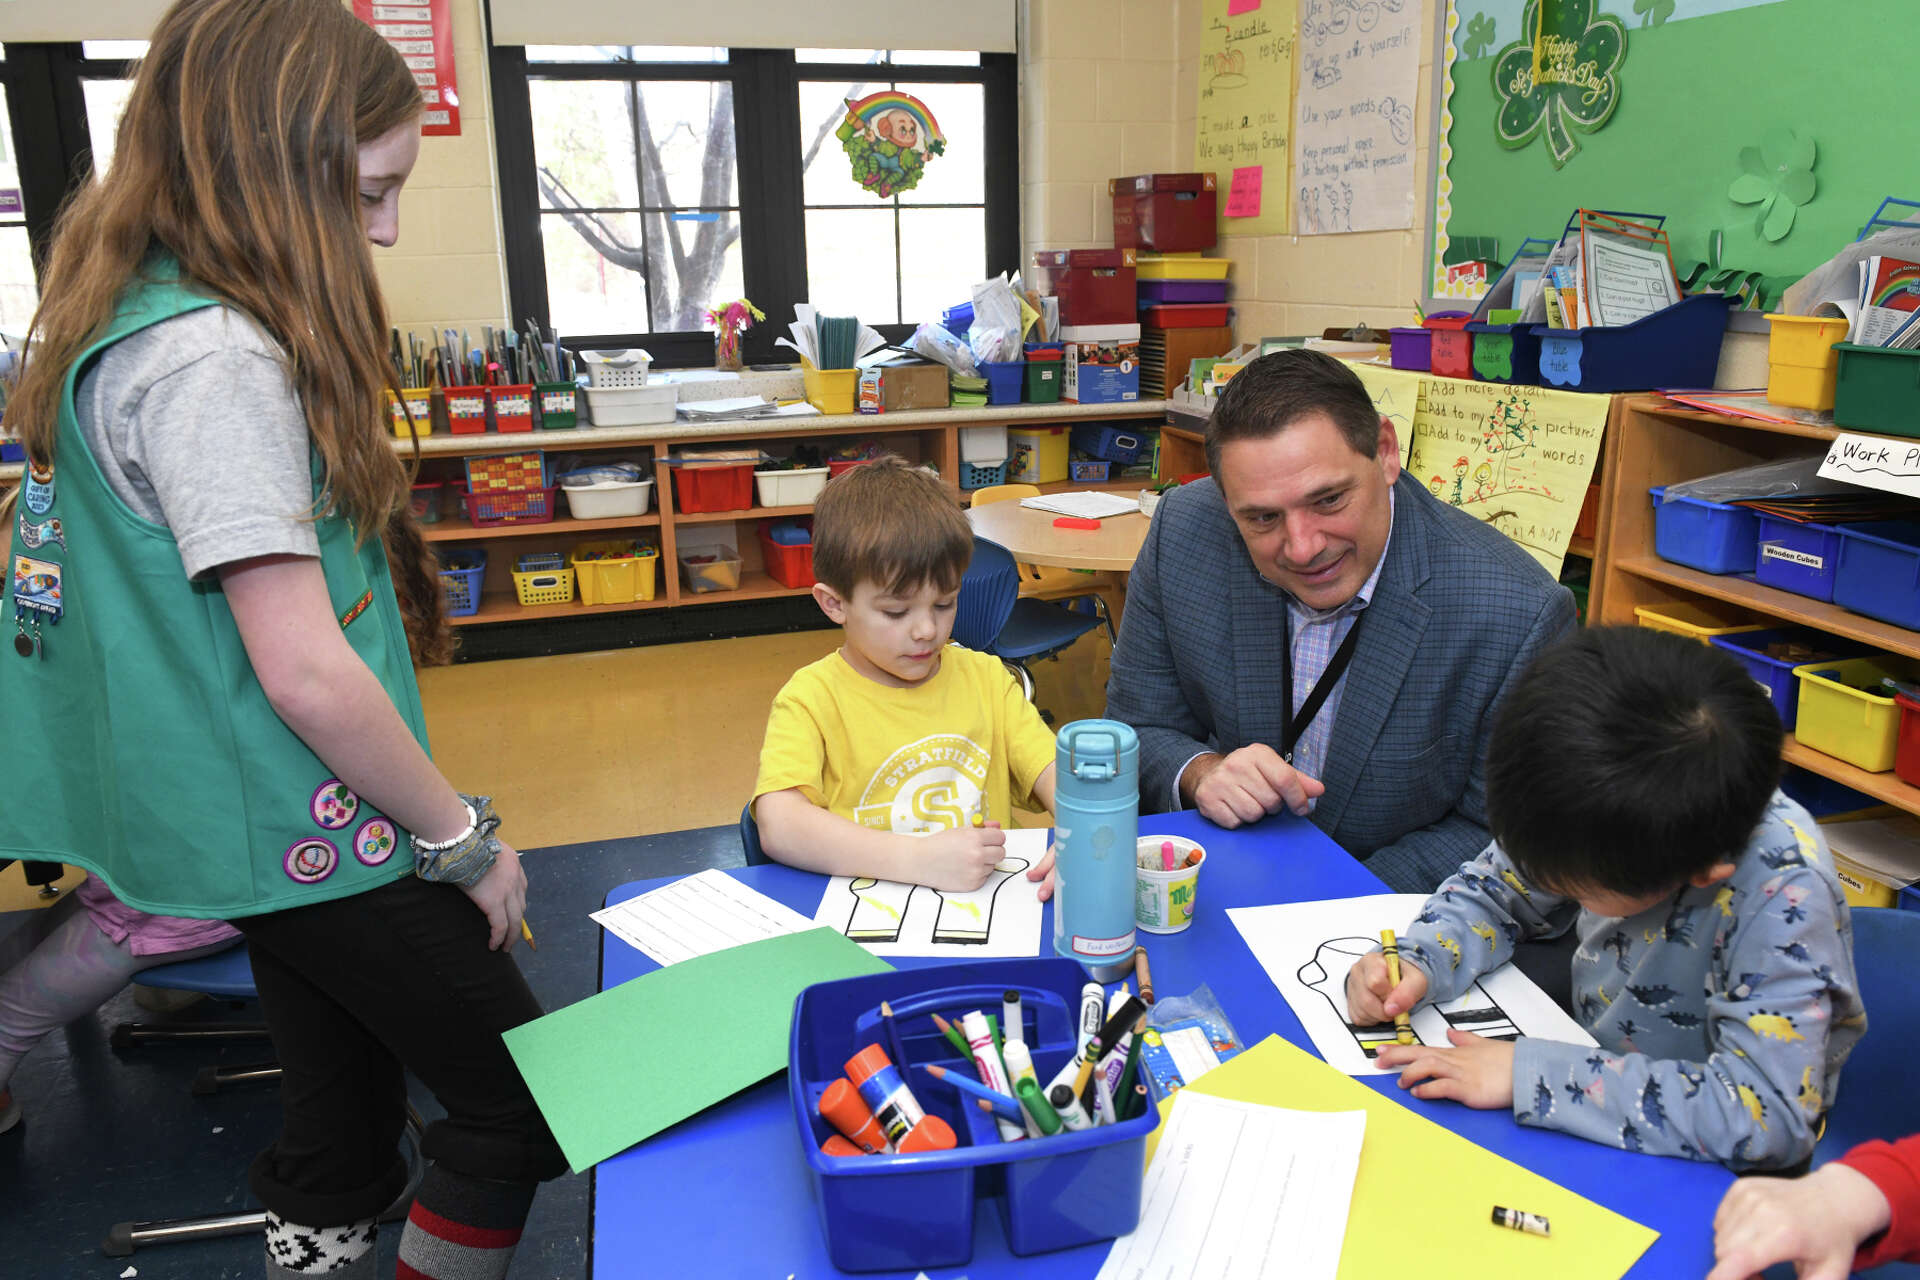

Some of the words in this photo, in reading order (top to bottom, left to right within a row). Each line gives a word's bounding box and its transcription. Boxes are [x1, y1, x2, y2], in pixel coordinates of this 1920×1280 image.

[1575, 60, 1608, 105] Day
[1430, 381, 1455, 395] Add
[1464, 384, 1496, 396] more
[1428, 401, 1447, 415] Add
[1452, 405, 1465, 419] to
[1471, 411, 1485, 430] my
[1428, 425, 1449, 441] Add
[1455, 430, 1466, 443] to
[1470, 436, 1484, 454] my
[1542, 448, 1585, 466] words
[1843, 441, 1890, 464] Work
[1766, 547, 1795, 560] Wooden
[1796, 554, 1819, 566] Cubes
[884, 747, 987, 788] STRATFIELD
[864, 815, 884, 827] SINCE
[1838, 872, 1862, 890] Cubes
